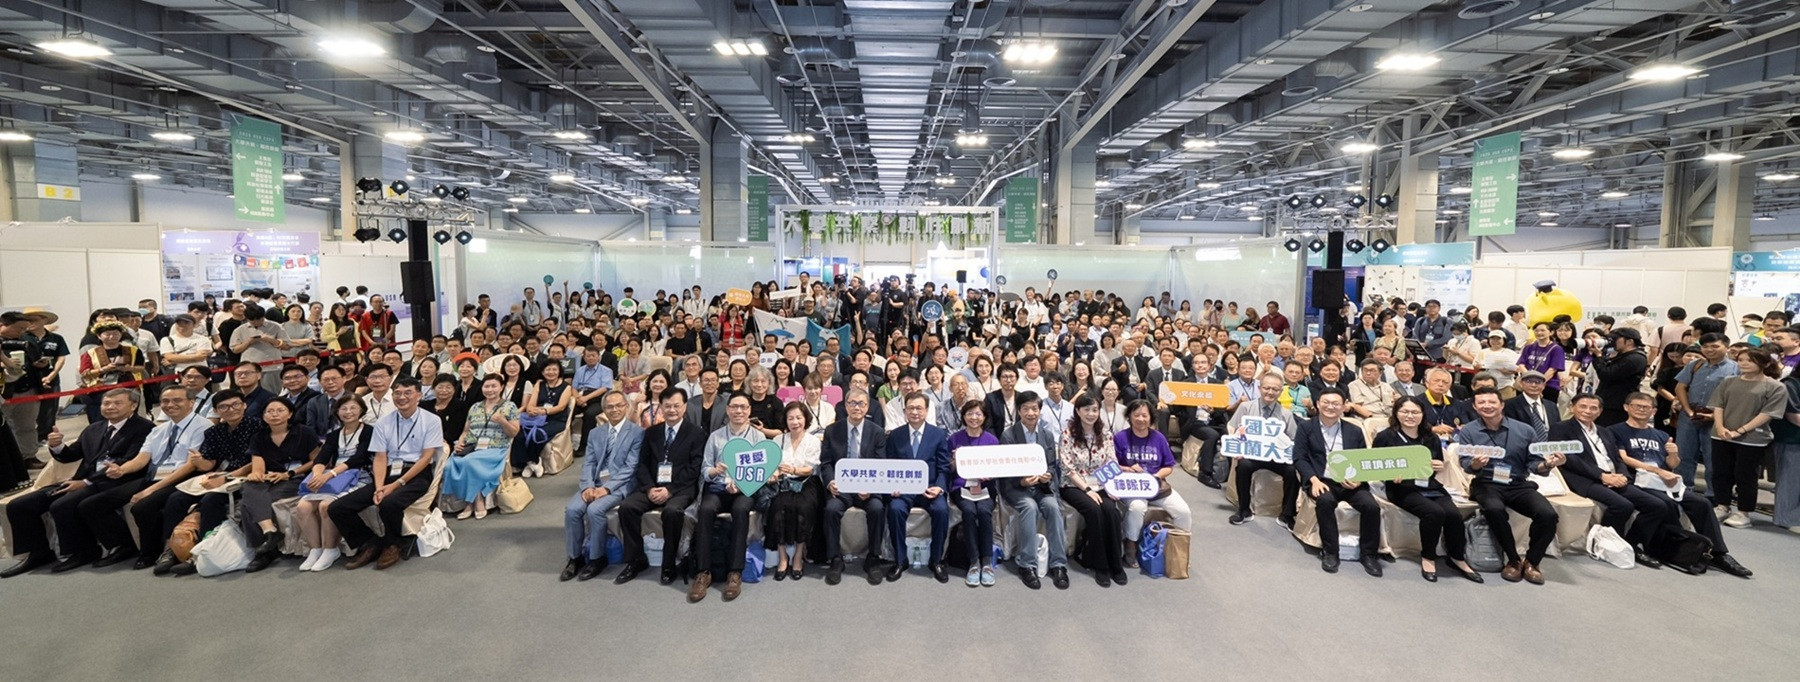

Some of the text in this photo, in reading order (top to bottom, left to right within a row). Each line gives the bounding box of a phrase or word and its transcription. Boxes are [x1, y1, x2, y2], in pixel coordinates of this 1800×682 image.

[1245, 418, 1282, 438] 國立
[739, 450, 764, 465] 我愛
[736, 466, 765, 482] USR
[1095, 462, 1121, 483] USR
[1114, 479, 1152, 491] 神隊友
